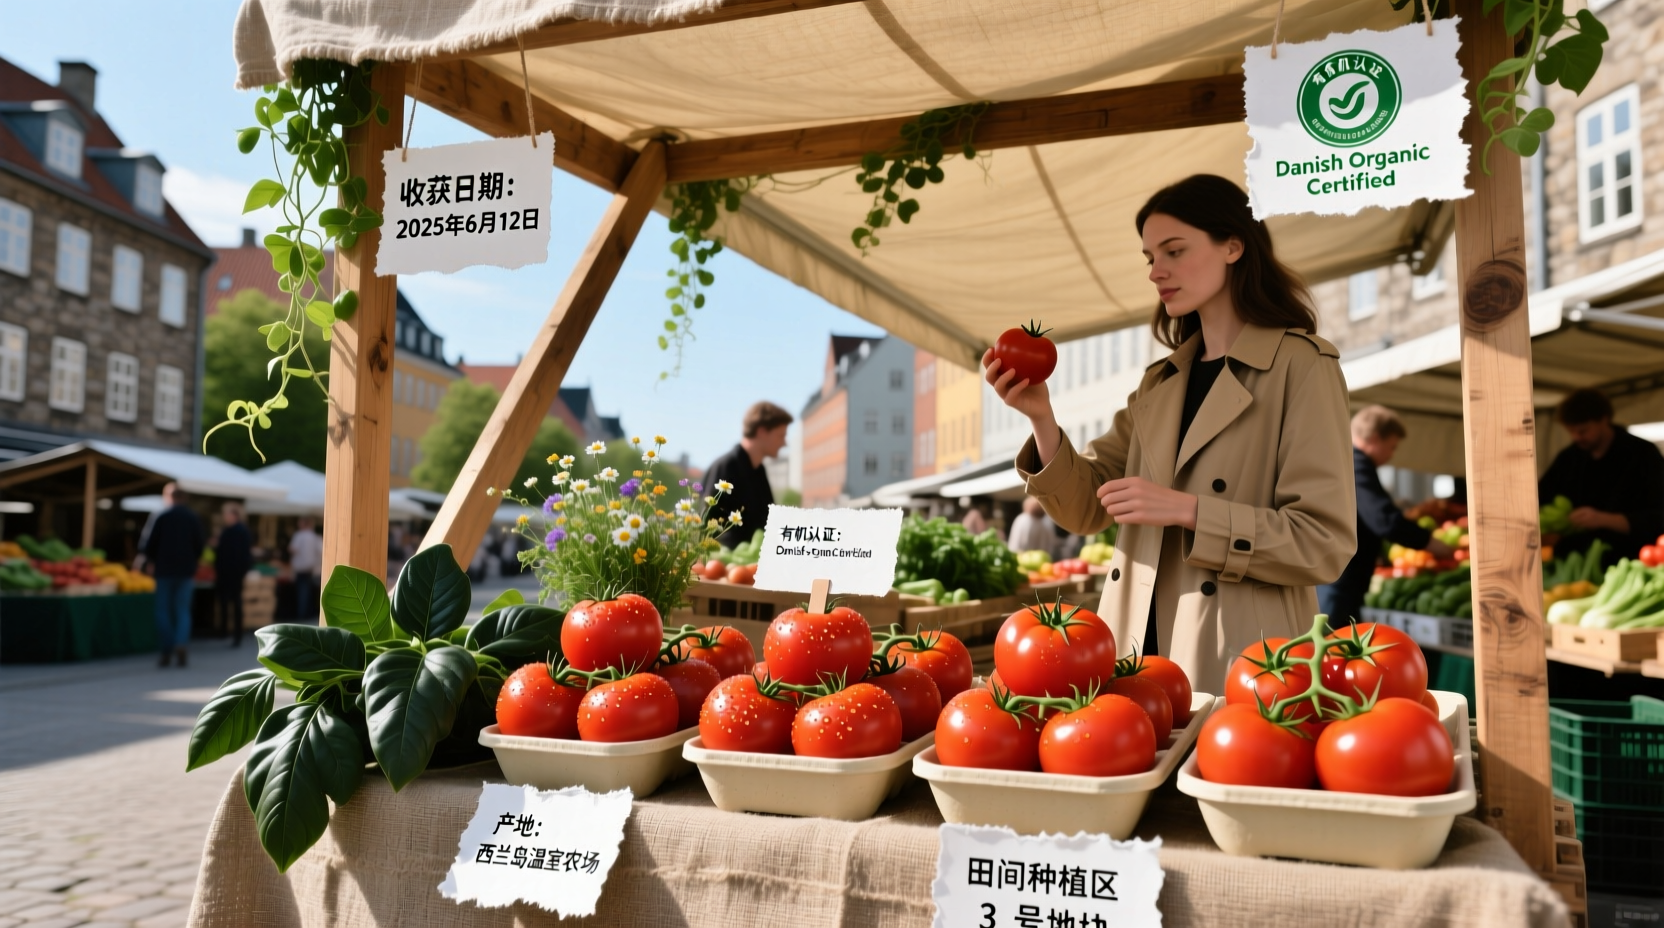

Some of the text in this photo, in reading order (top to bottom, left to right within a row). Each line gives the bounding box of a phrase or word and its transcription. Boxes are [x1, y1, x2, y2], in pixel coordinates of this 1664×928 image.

[1275, 142, 1431, 178] Danish Organic
[400, 171, 514, 208] 收获日期：
[1306, 169, 1396, 196] Certified
[395, 207, 539, 240] 2025年6月12日
[492, 811, 543, 838] 产地：
[475, 842, 601, 875] 西兰岛温室农场
[968, 856, 1119, 902] 田间种植区
[979, 902, 997, 928] 3
